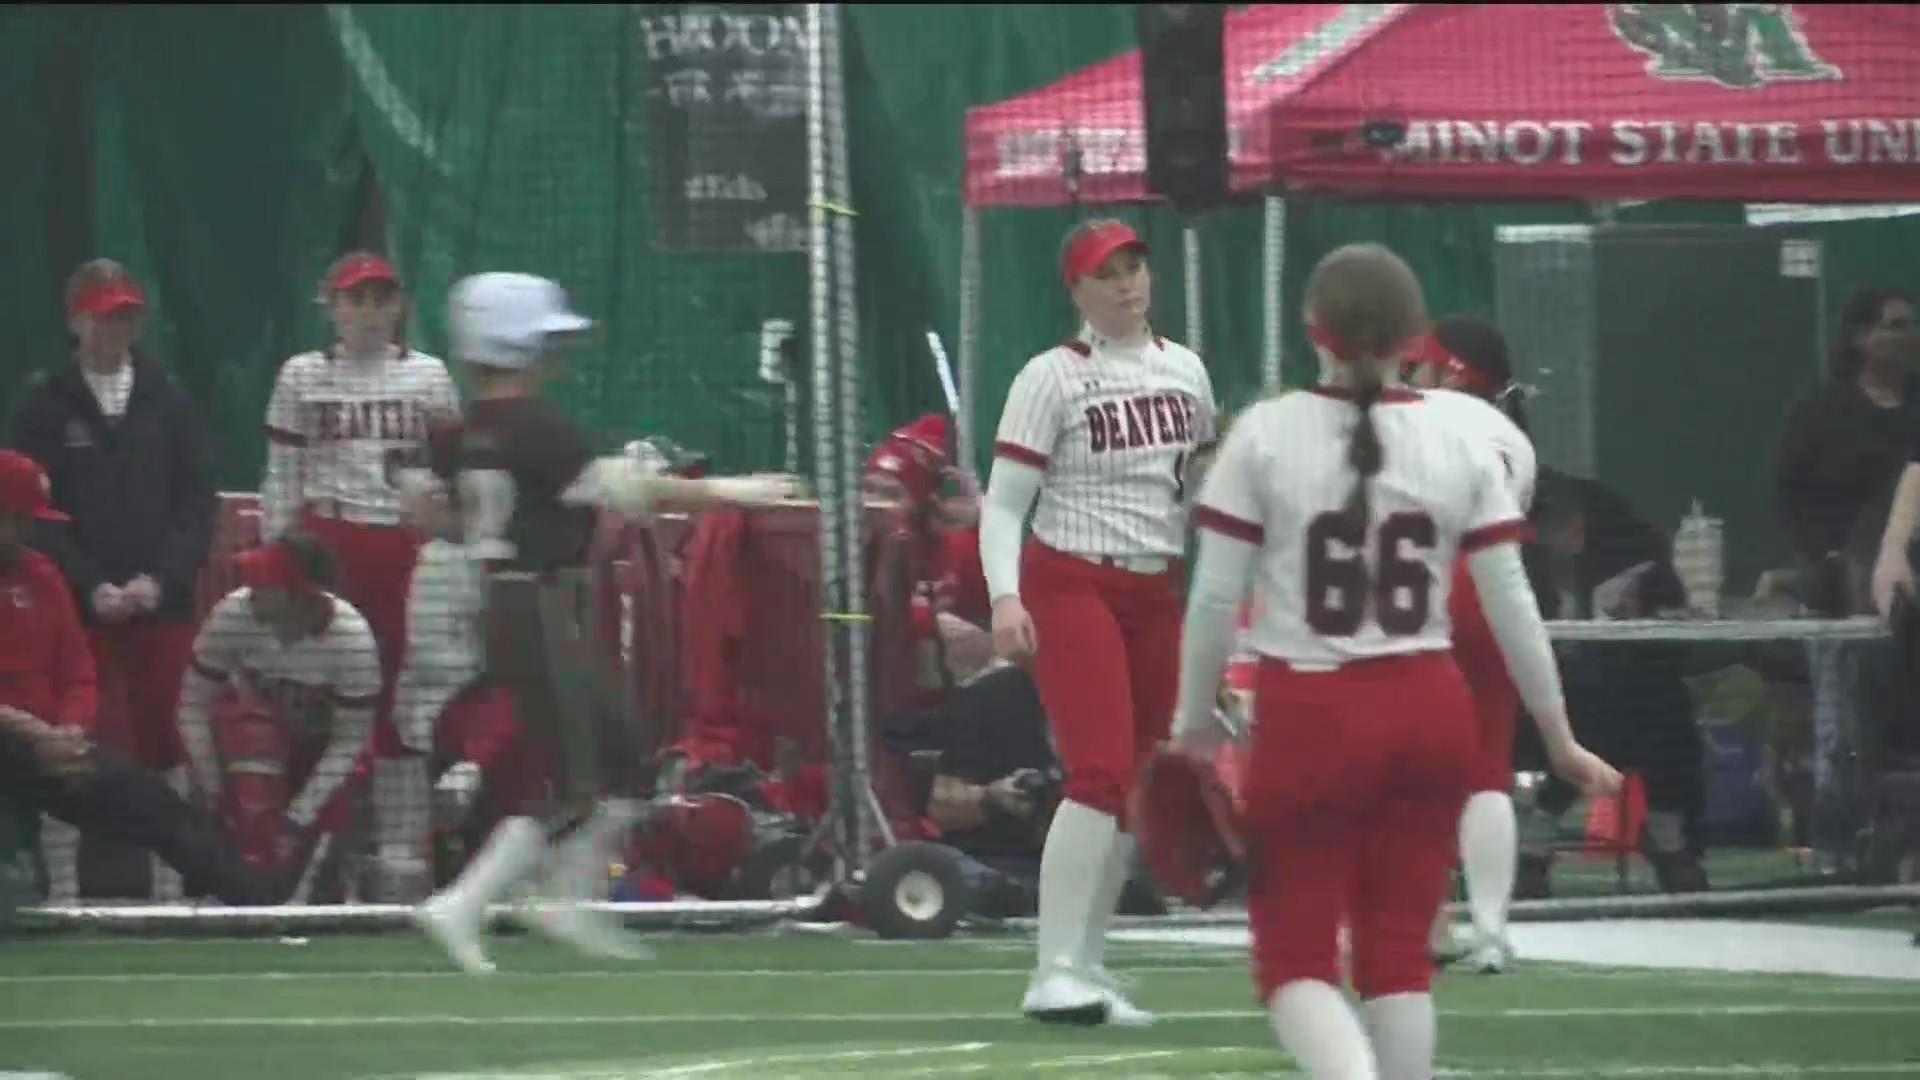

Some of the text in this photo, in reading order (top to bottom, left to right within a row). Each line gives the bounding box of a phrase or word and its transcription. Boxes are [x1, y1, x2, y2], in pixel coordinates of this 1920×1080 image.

[1389, 119, 1593, 164] MINOT
[1610, 120, 1800, 165] STATE
[1305, 509, 1438, 637] 66
